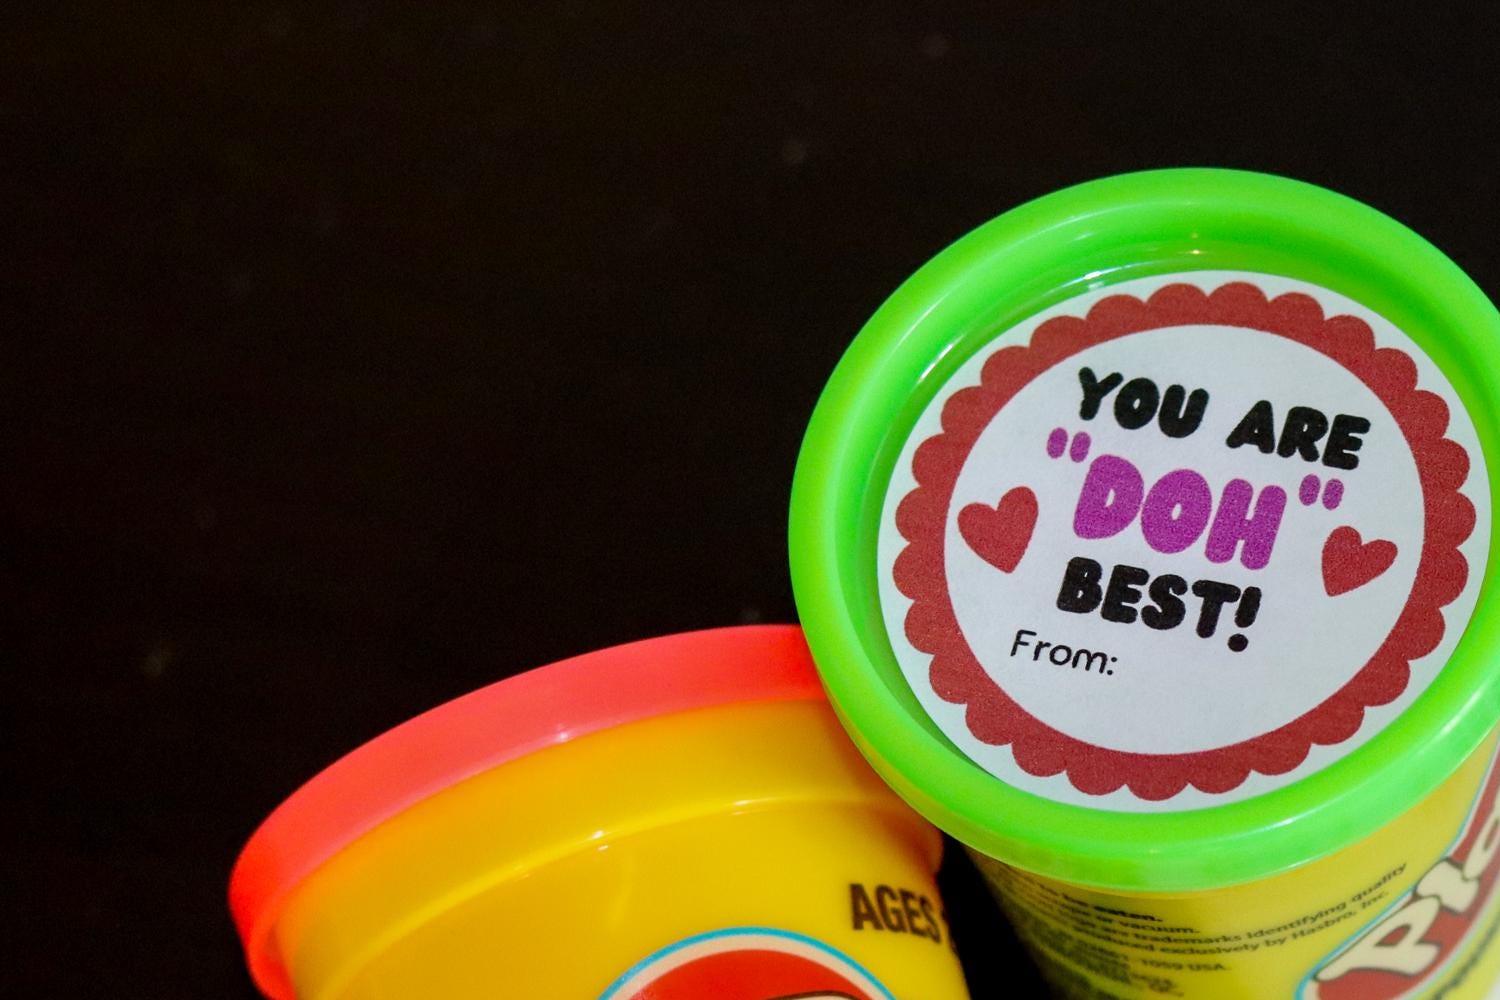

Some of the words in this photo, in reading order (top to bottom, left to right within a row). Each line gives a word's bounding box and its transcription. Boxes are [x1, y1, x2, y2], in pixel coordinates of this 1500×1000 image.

[1078, 366, 1209, 438] YOU
[1225, 399, 1371, 471] ARE
[1046, 427, 1344, 570] "DOH"
[1056, 556, 1262, 652] BEST!
[1010, 629, 1117, 676] From:
[850, 883, 942, 944] AGES
[1133, 930, 1241, 945] trademarks
[1247, 901, 1347, 940] identifying
[1351, 862, 1407, 903] quality
